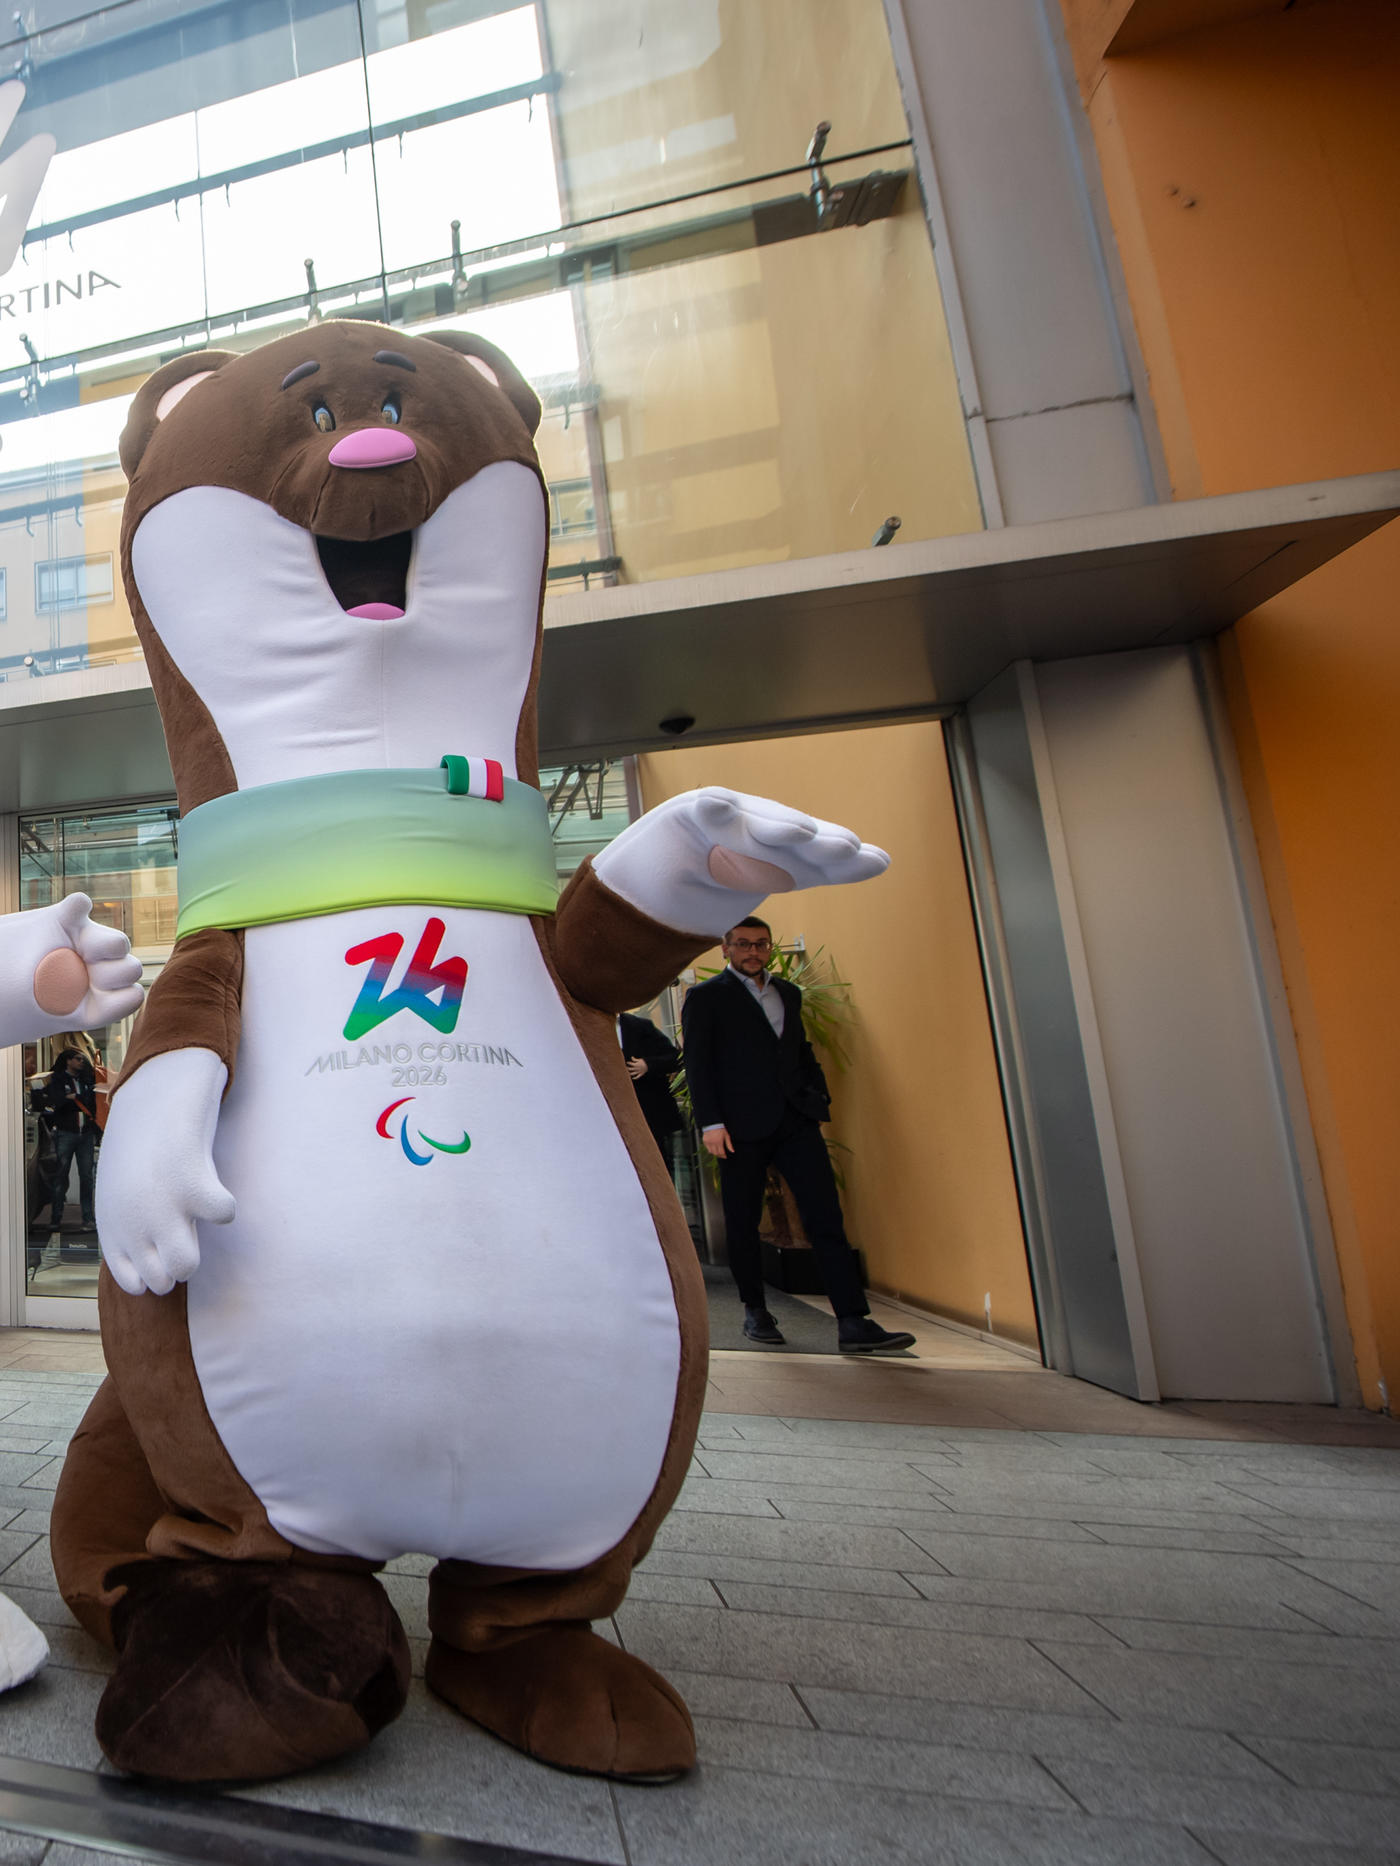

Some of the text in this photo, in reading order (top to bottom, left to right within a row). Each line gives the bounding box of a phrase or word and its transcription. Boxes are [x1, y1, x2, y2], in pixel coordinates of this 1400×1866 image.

[304, 1043, 524, 1077] MILANO CORTINA
[391, 1065, 448, 1088] 2026
